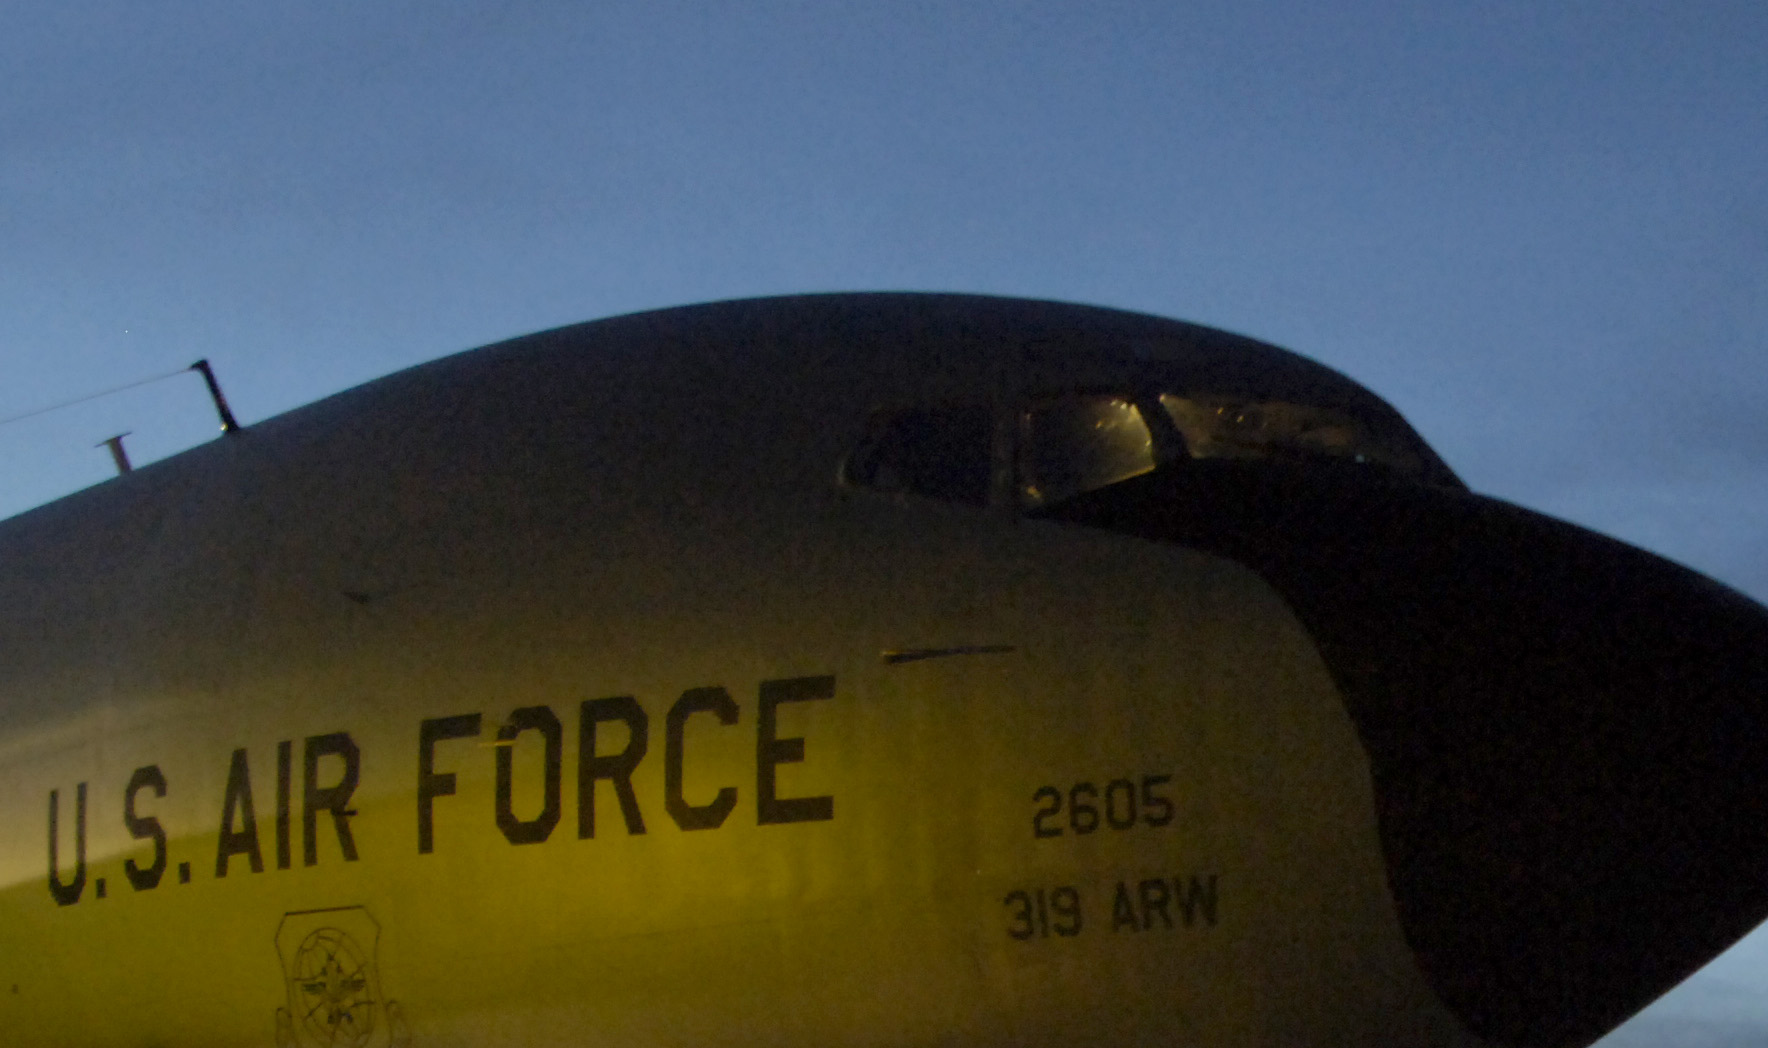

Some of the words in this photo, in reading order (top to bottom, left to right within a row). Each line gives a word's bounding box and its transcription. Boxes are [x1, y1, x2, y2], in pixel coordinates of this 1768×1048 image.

[48, 765, 191, 906] U.S.
[214, 731, 361, 878] AIR
[418, 674, 837, 854] FORCE
[1032, 774, 1175, 838] 2605
[1003, 886, 1083, 942] 319
[1111, 875, 1219, 933] ARW
